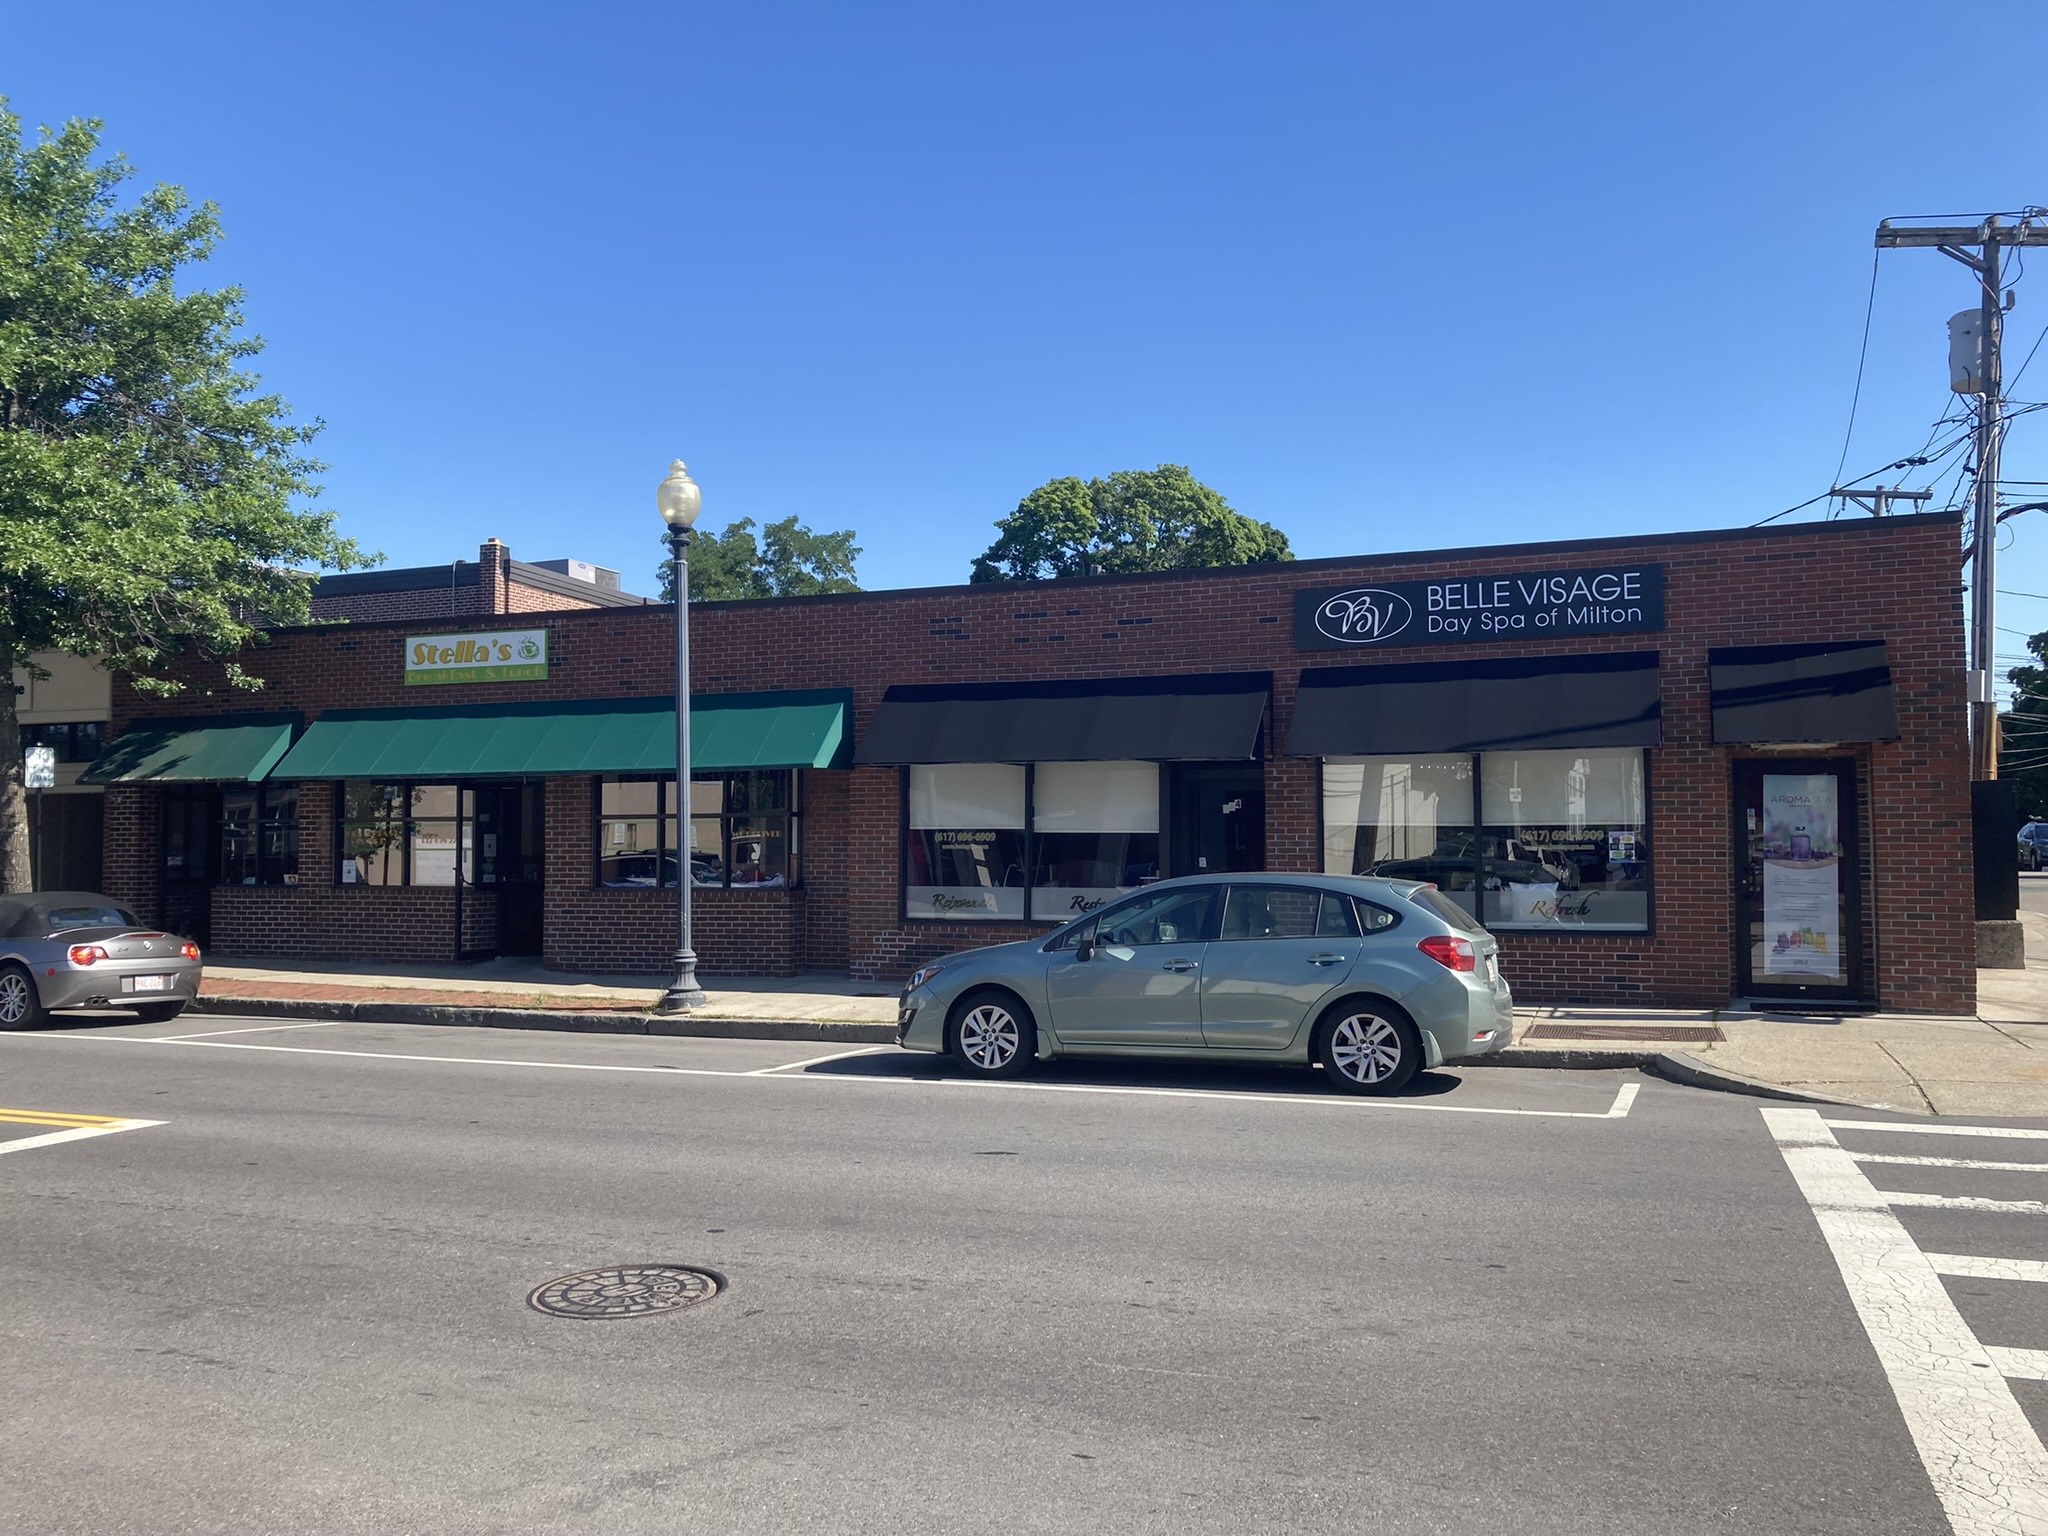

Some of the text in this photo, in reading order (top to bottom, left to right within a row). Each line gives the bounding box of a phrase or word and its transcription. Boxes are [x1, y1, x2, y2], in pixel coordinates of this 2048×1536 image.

[1427, 572, 1641, 612] BELLE VISAGE
[1428, 605, 1642, 635] Day Spa of Milton
[411, 638, 513, 665] Stella's
[407, 665, 544, 683] Breakfast & Lunch
[934, 831, 996, 843] (617) 696-6909
